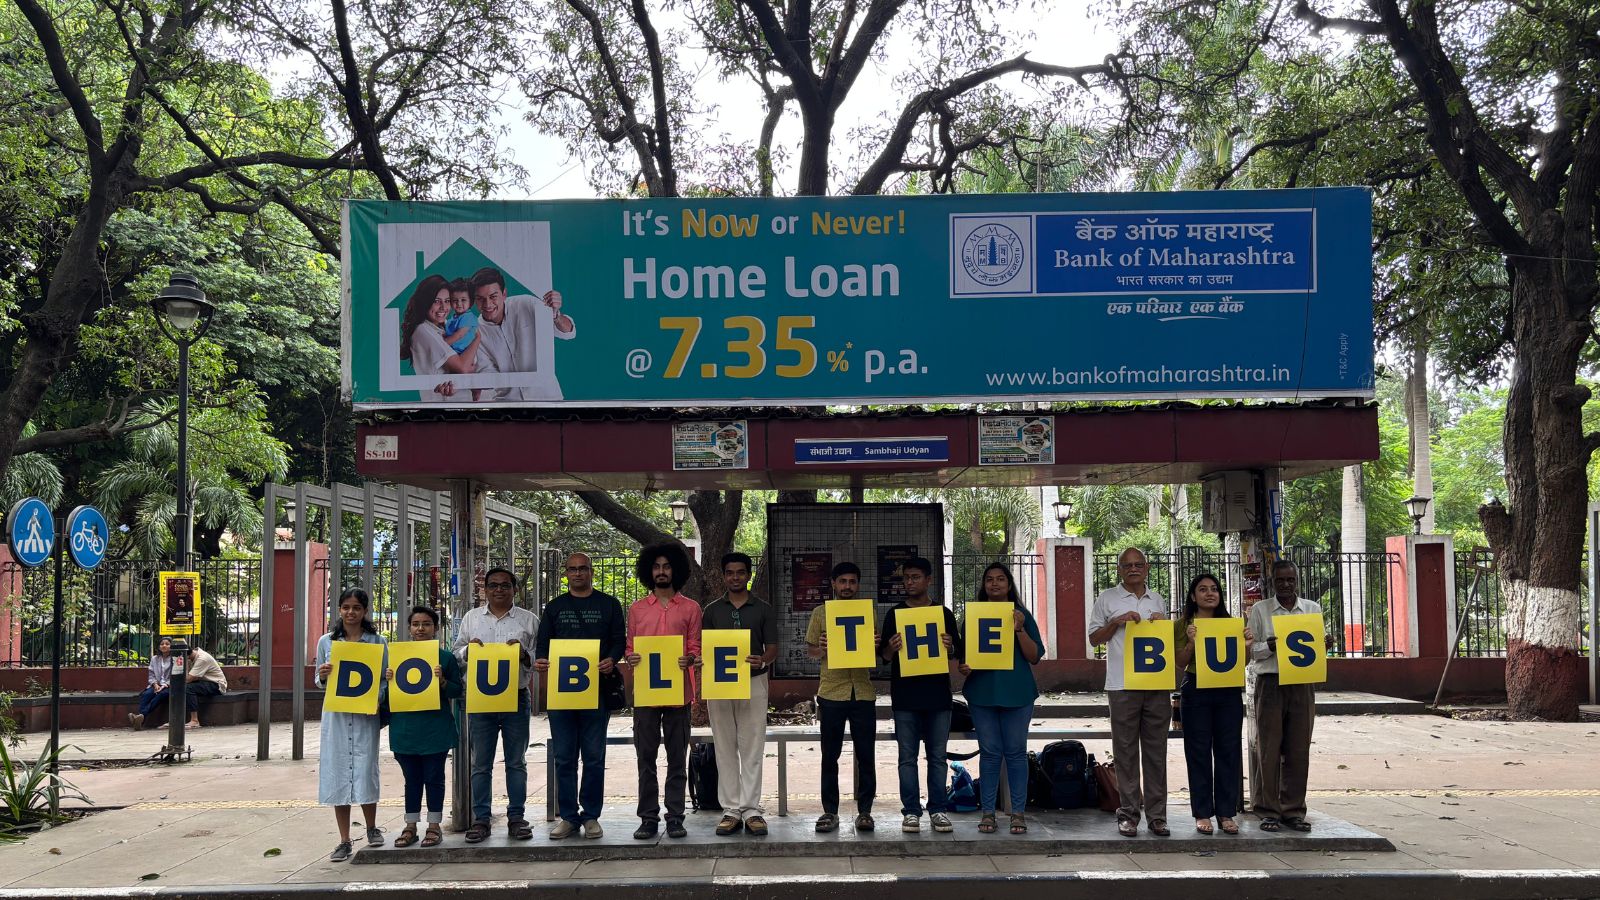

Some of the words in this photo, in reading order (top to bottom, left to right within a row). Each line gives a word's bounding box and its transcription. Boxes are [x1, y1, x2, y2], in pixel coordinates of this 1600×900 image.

[623, 209, 669, 236] It's
[681, 208, 759, 238] Now
[771, 214, 799, 235] or
[811, 209, 905, 236] Never!
[1074, 218, 1118, 241] बैंक
[1125, 218, 1180, 241] ऑफ
[1186, 223, 1275, 244] महाराष्ट्र
[1054, 248, 1114, 268] Bank
[1119, 246, 1144, 267] of
[1149, 246, 1296, 267] Maharashtra
[623, 257, 767, 299] Home
[784, 256, 900, 298] Loan
[1116, 275, 1143, 286] भारत
[1148, 274, 1184, 286] सरकार
[1188, 274, 1203, 285] का
[1206, 274, 1233, 285] उद्यम
[1106, 302, 1133, 315] एक
[1136, 297, 1183, 314] परिवार
[1189, 301, 1216, 314] एक
[1218, 296, 1245, 313] बैंक
[1338, 332, 1349, 356] Apply
[865, 348, 928, 383] p.a.
[986, 364, 1290, 386] www.bankofmaharashtra.in
[366, 450, 396, 458] SS-101
[809, 446, 833, 456] संभाजी
[864, 447, 901, 456] Sambhaji
[903, 446, 929, 455] Udyan
